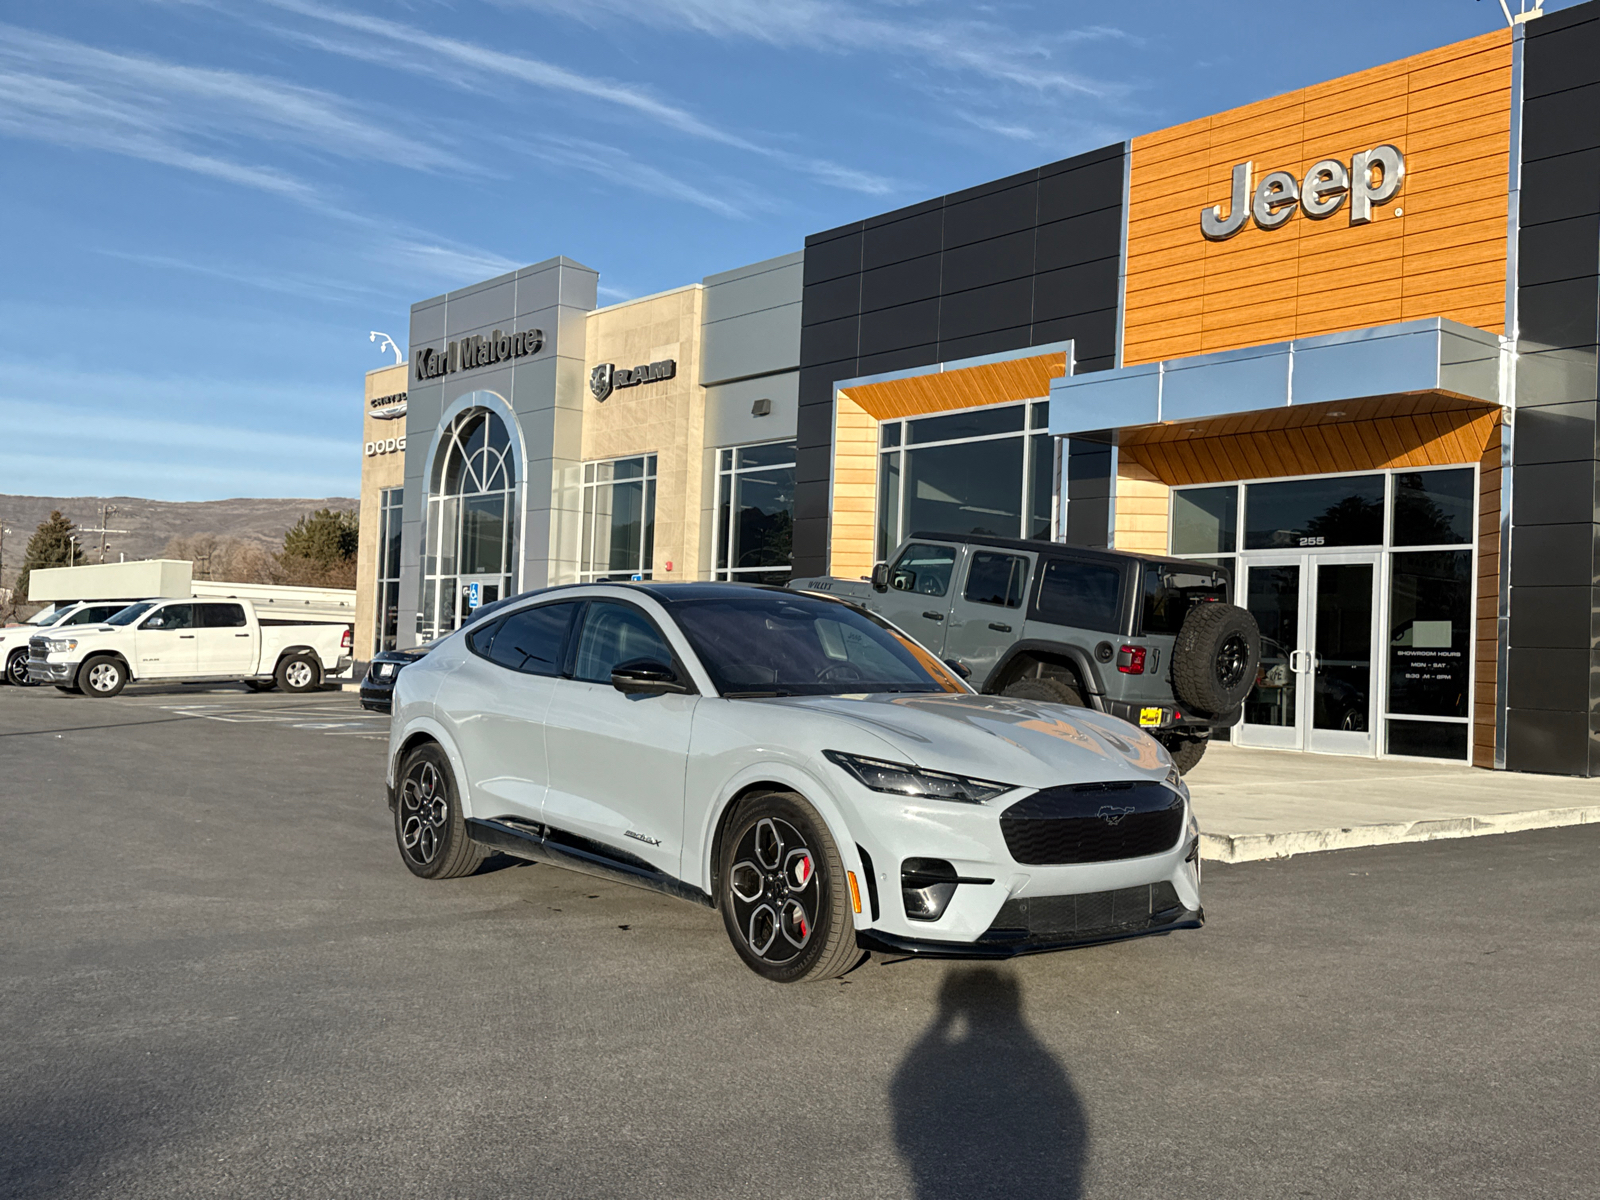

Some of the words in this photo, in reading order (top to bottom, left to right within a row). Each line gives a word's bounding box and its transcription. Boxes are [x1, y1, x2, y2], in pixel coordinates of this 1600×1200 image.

[1201, 144, 1405, 242] Jeep
[415, 341, 458, 381] Karl
[459, 328, 543, 370] Malone
[613, 359, 676, 390] RAM
[365, 436, 406, 457] DODG
[1299, 536, 1325, 546] 255
[808, 580, 834, 590] WILLYS
